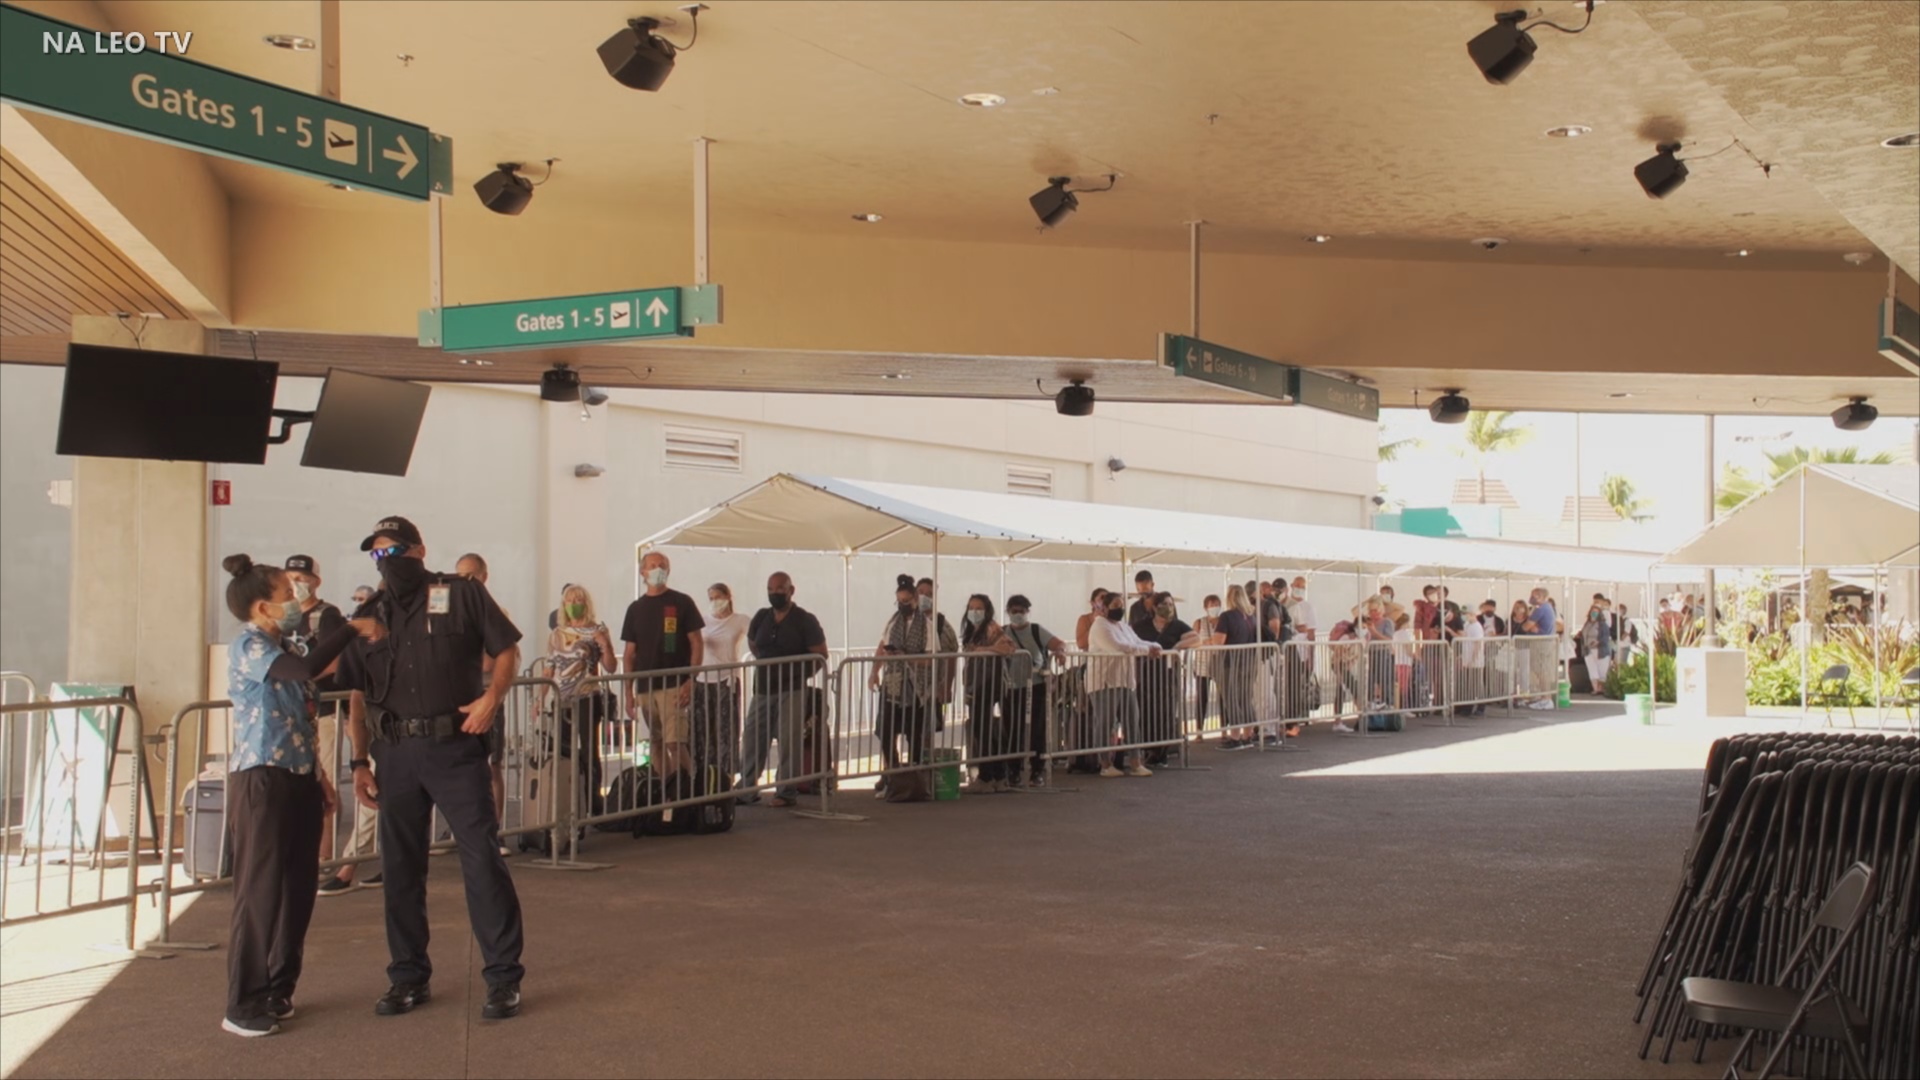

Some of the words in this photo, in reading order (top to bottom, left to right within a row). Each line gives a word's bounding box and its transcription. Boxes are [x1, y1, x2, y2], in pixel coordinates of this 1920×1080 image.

[131, 73, 236, 129] Gates
[250, 105, 264, 136] 1
[296, 116, 312, 147] 5
[516, 313, 564, 332] Gates
[570, 309, 578, 328] 1
[594, 307, 604, 326] 5
[1214, 357, 1236, 377] Gates
